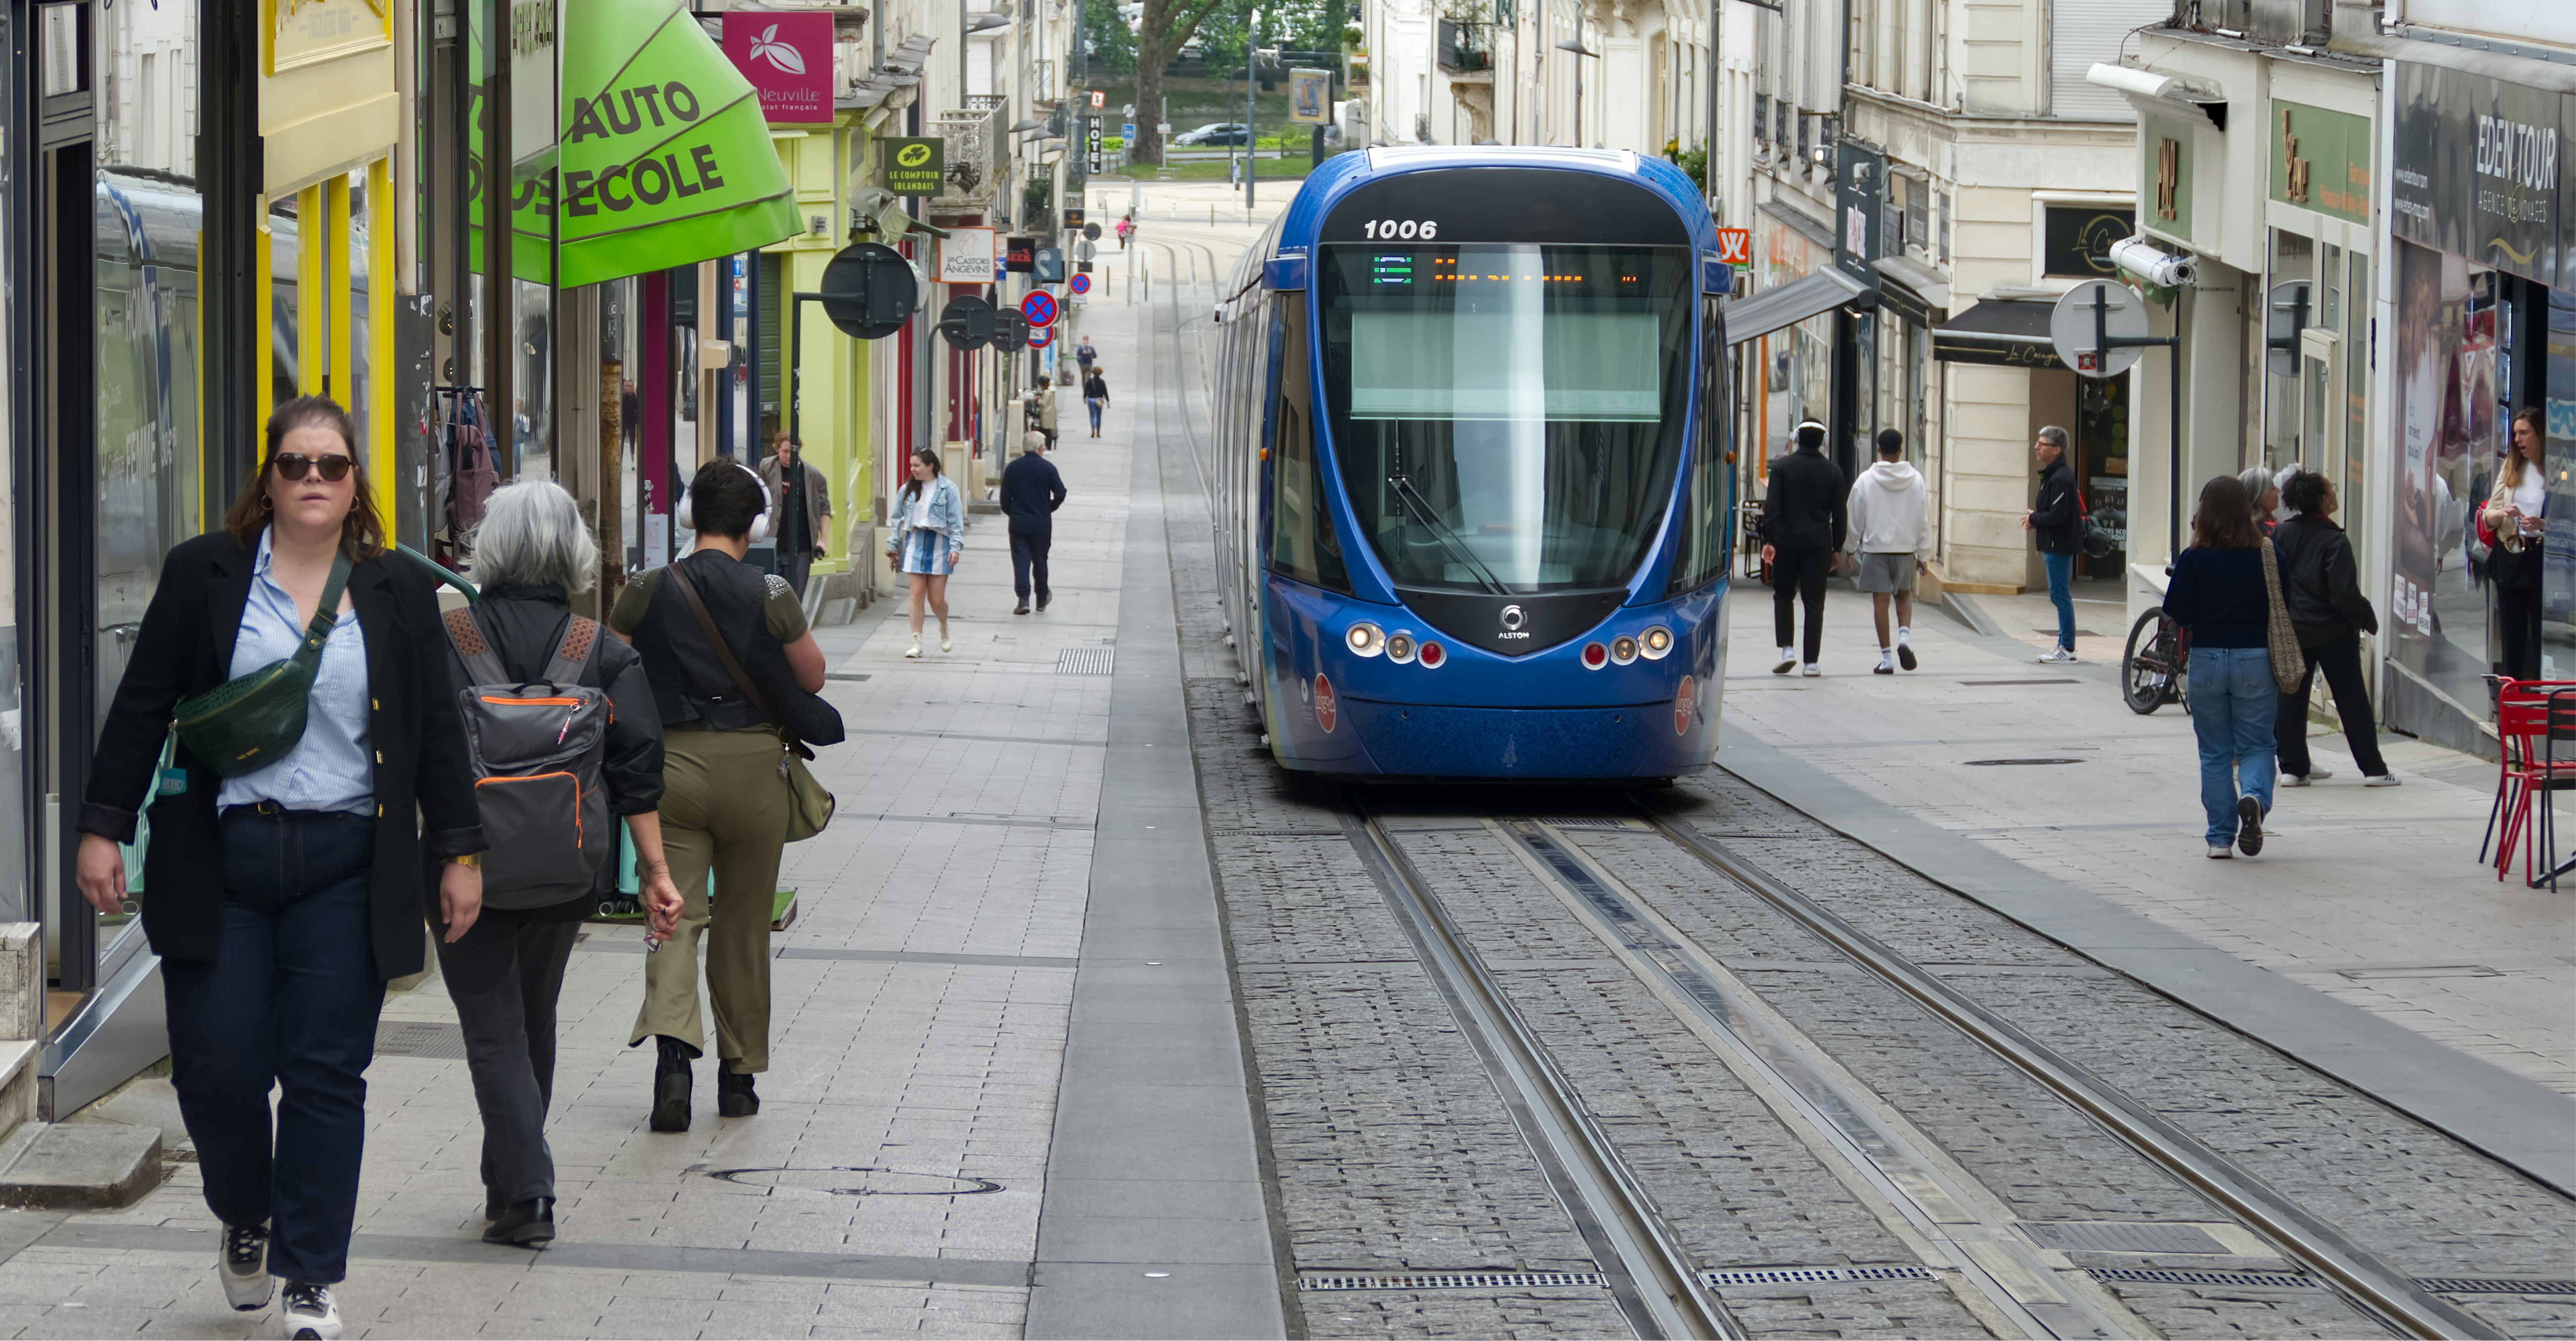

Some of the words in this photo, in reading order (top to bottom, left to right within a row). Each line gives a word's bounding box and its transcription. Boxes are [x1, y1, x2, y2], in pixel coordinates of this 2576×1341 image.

[571, 81, 700, 144] AUTO
[1090, 118, 1100, 173] HOTEL
[2477, 114, 2515, 180] EDEN
[2518, 124, 2556, 191] TOUR
[564, 144, 724, 217] ECOLE
[2396, 164, 2427, 189] www.edentour.com
[2478, 190, 2505, 215] AGENCE
[2519, 199, 2546, 223] VOYAGES
[1365, 220, 1438, 240] 1006
[944, 263, 990, 273] ANGEVINS
[2006, 344, 2019, 361] La
[126, 421, 155, 487] FEMME
